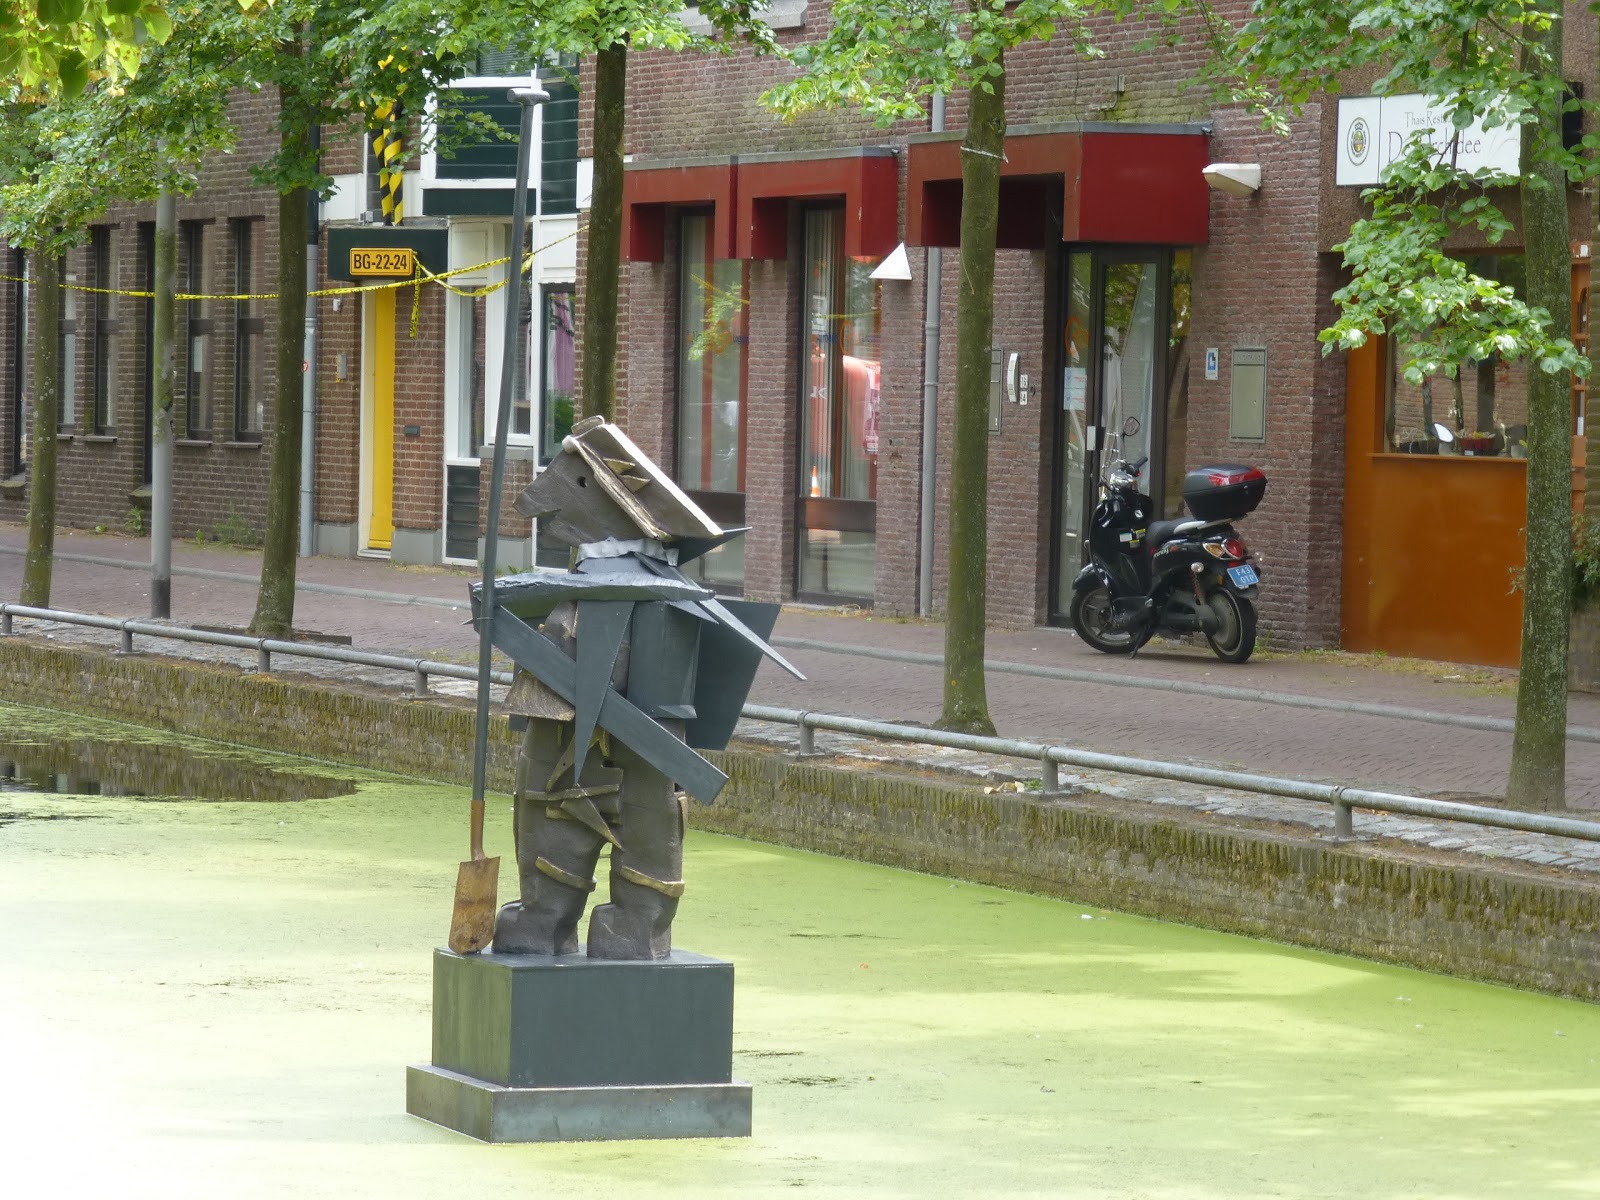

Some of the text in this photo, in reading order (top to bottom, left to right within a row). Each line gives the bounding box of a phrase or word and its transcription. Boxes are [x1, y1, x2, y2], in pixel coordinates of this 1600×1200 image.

[1404, 111, 1425, 128] Thais
[1420, 127, 1481, 156] rchdee
[353, 253, 407, 270] BG-22-24
[1235, 566, 1251, 576] F43
